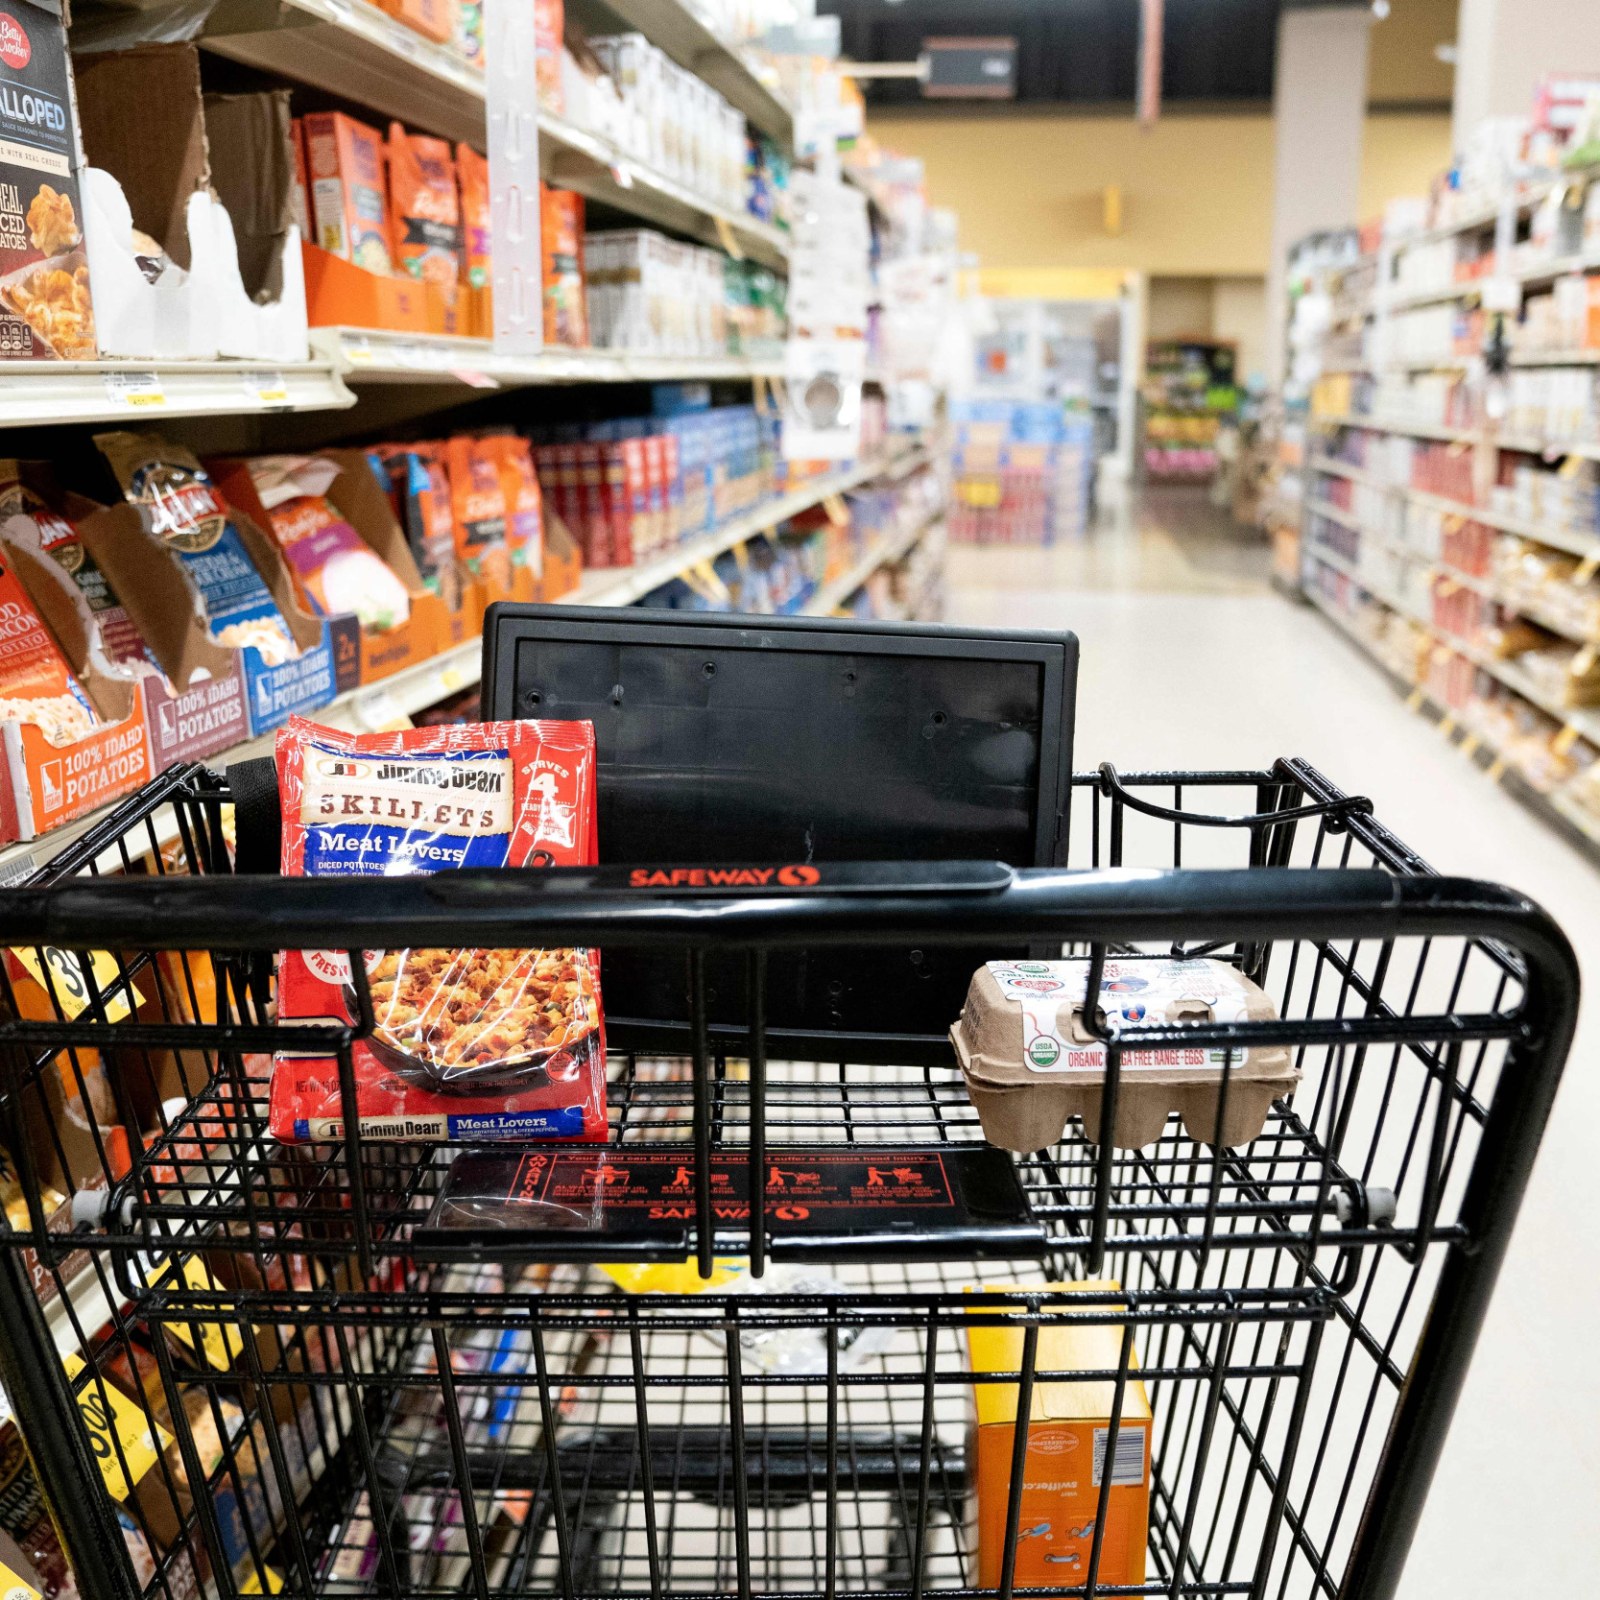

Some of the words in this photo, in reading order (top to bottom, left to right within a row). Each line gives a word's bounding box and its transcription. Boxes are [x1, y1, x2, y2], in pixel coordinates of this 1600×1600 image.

[7, 149, 23, 160] WITH
[25, 153, 41, 163] REAL
[176, 688, 207, 717] 100%
[208, 676, 240, 706] IDAHO
[273, 667, 332, 712] POTATOES
[178, 697, 242, 743] POTATOES
[65, 743, 103, 777] 100%
[104, 724, 144, 760] IDAHO
[66, 747, 146, 805] POTATOES
[376, 764, 450, 790] Jimmy
[450, 766, 502, 794] Dean
[521, 759, 570, 779] SERVES
[528, 772, 559, 801] 4
[319, 793, 494, 829] SKILLETS
[318, 831, 384, 852] Meat
[386, 835, 466, 863] Lovers
[317, 861, 343, 870] DICED
[343, 861, 386, 871] POTATOES
[629, 867, 775, 888] SAFEWAY
[310, 951, 349, 977] FRESH
[1034, 1051, 1057, 1059] ORGANIC
[1068, 1050, 1104, 1068] ORGANIC
[1133, 1050, 1153, 1067] FREE
[358, 1122, 405, 1138] Jimmy
[404, 1120, 440, 1136] Dean
[456, 1118, 497, 1130] Meat
[497, 1116, 548, 1128] Lovers
